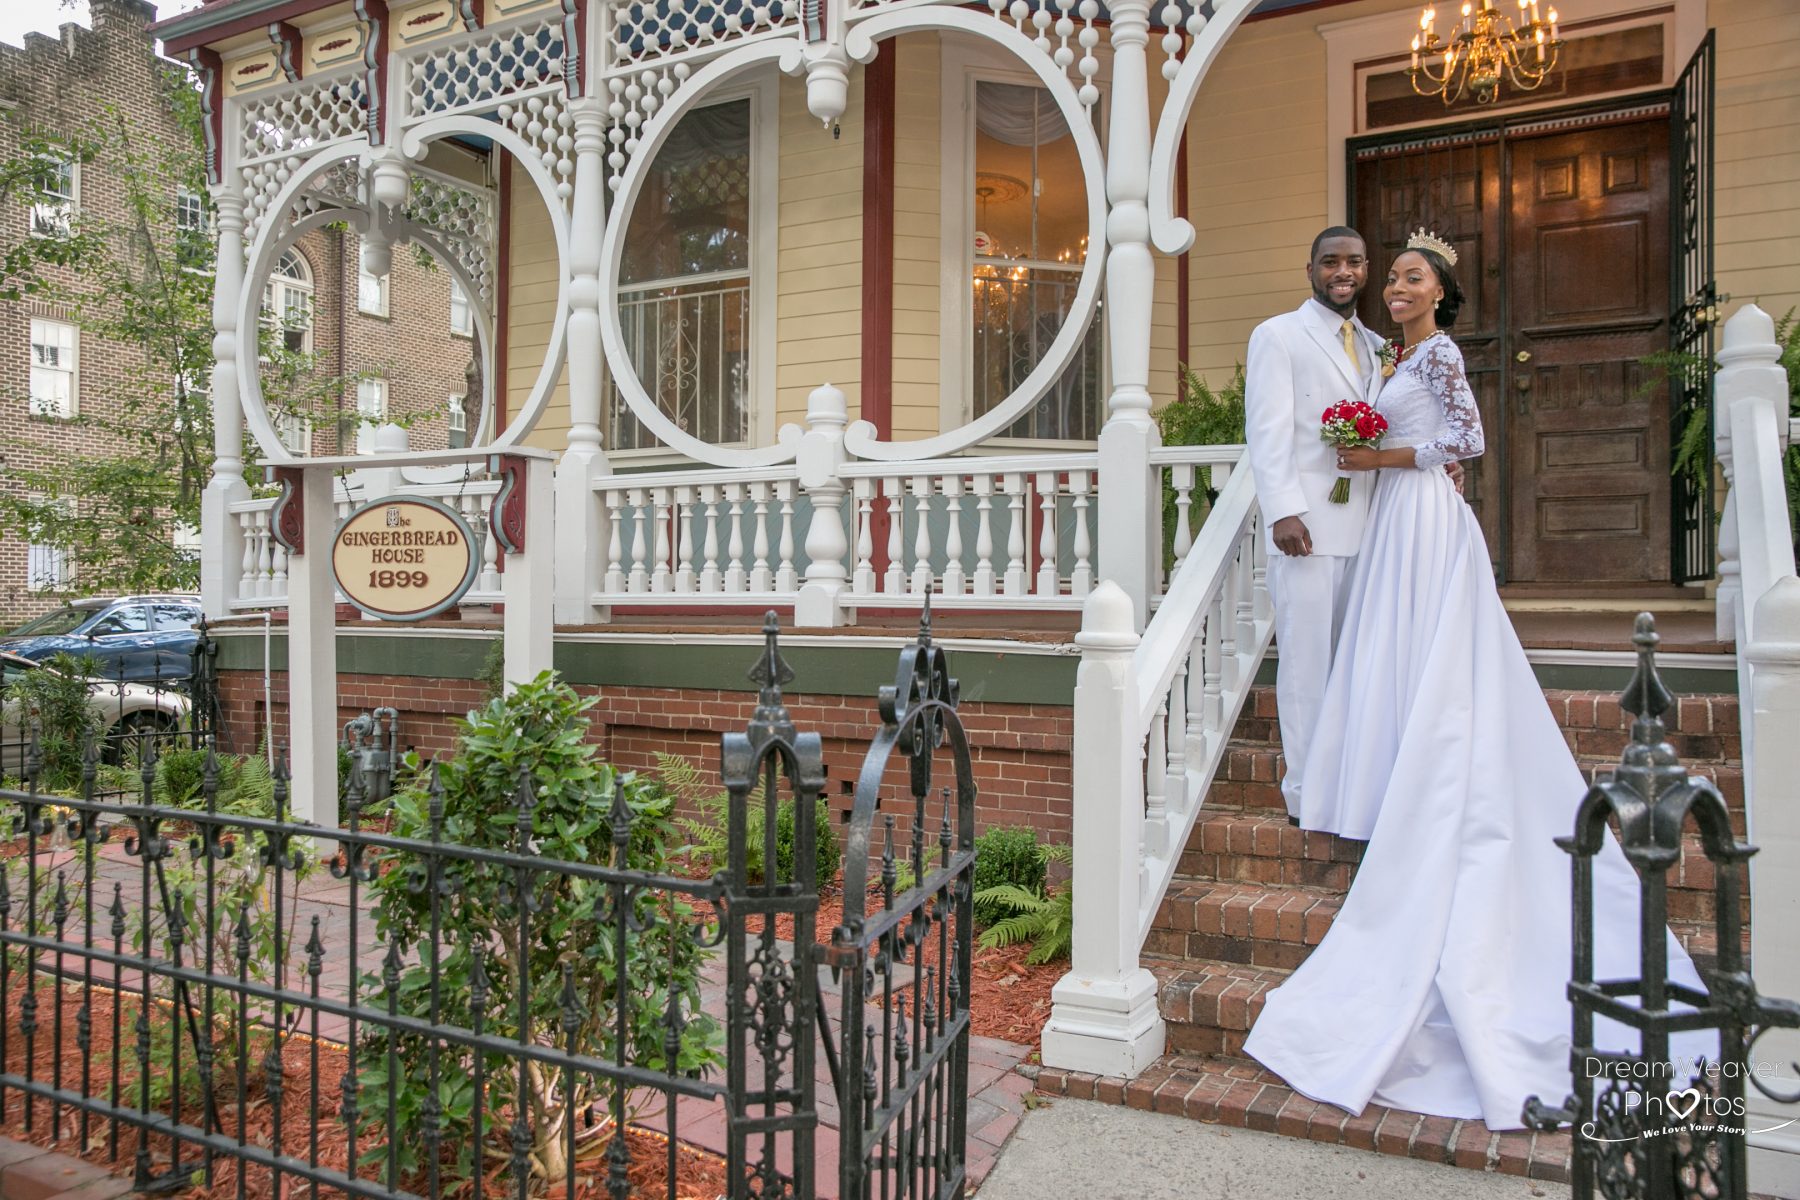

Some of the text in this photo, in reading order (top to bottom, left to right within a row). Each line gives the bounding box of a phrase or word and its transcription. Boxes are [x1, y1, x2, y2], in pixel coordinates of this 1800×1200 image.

[386, 508, 411, 527] The
[342, 531, 458, 546] GINGERBREAD
[371, 549, 424, 564] HOUSE
[369, 570, 429, 588] 1899
